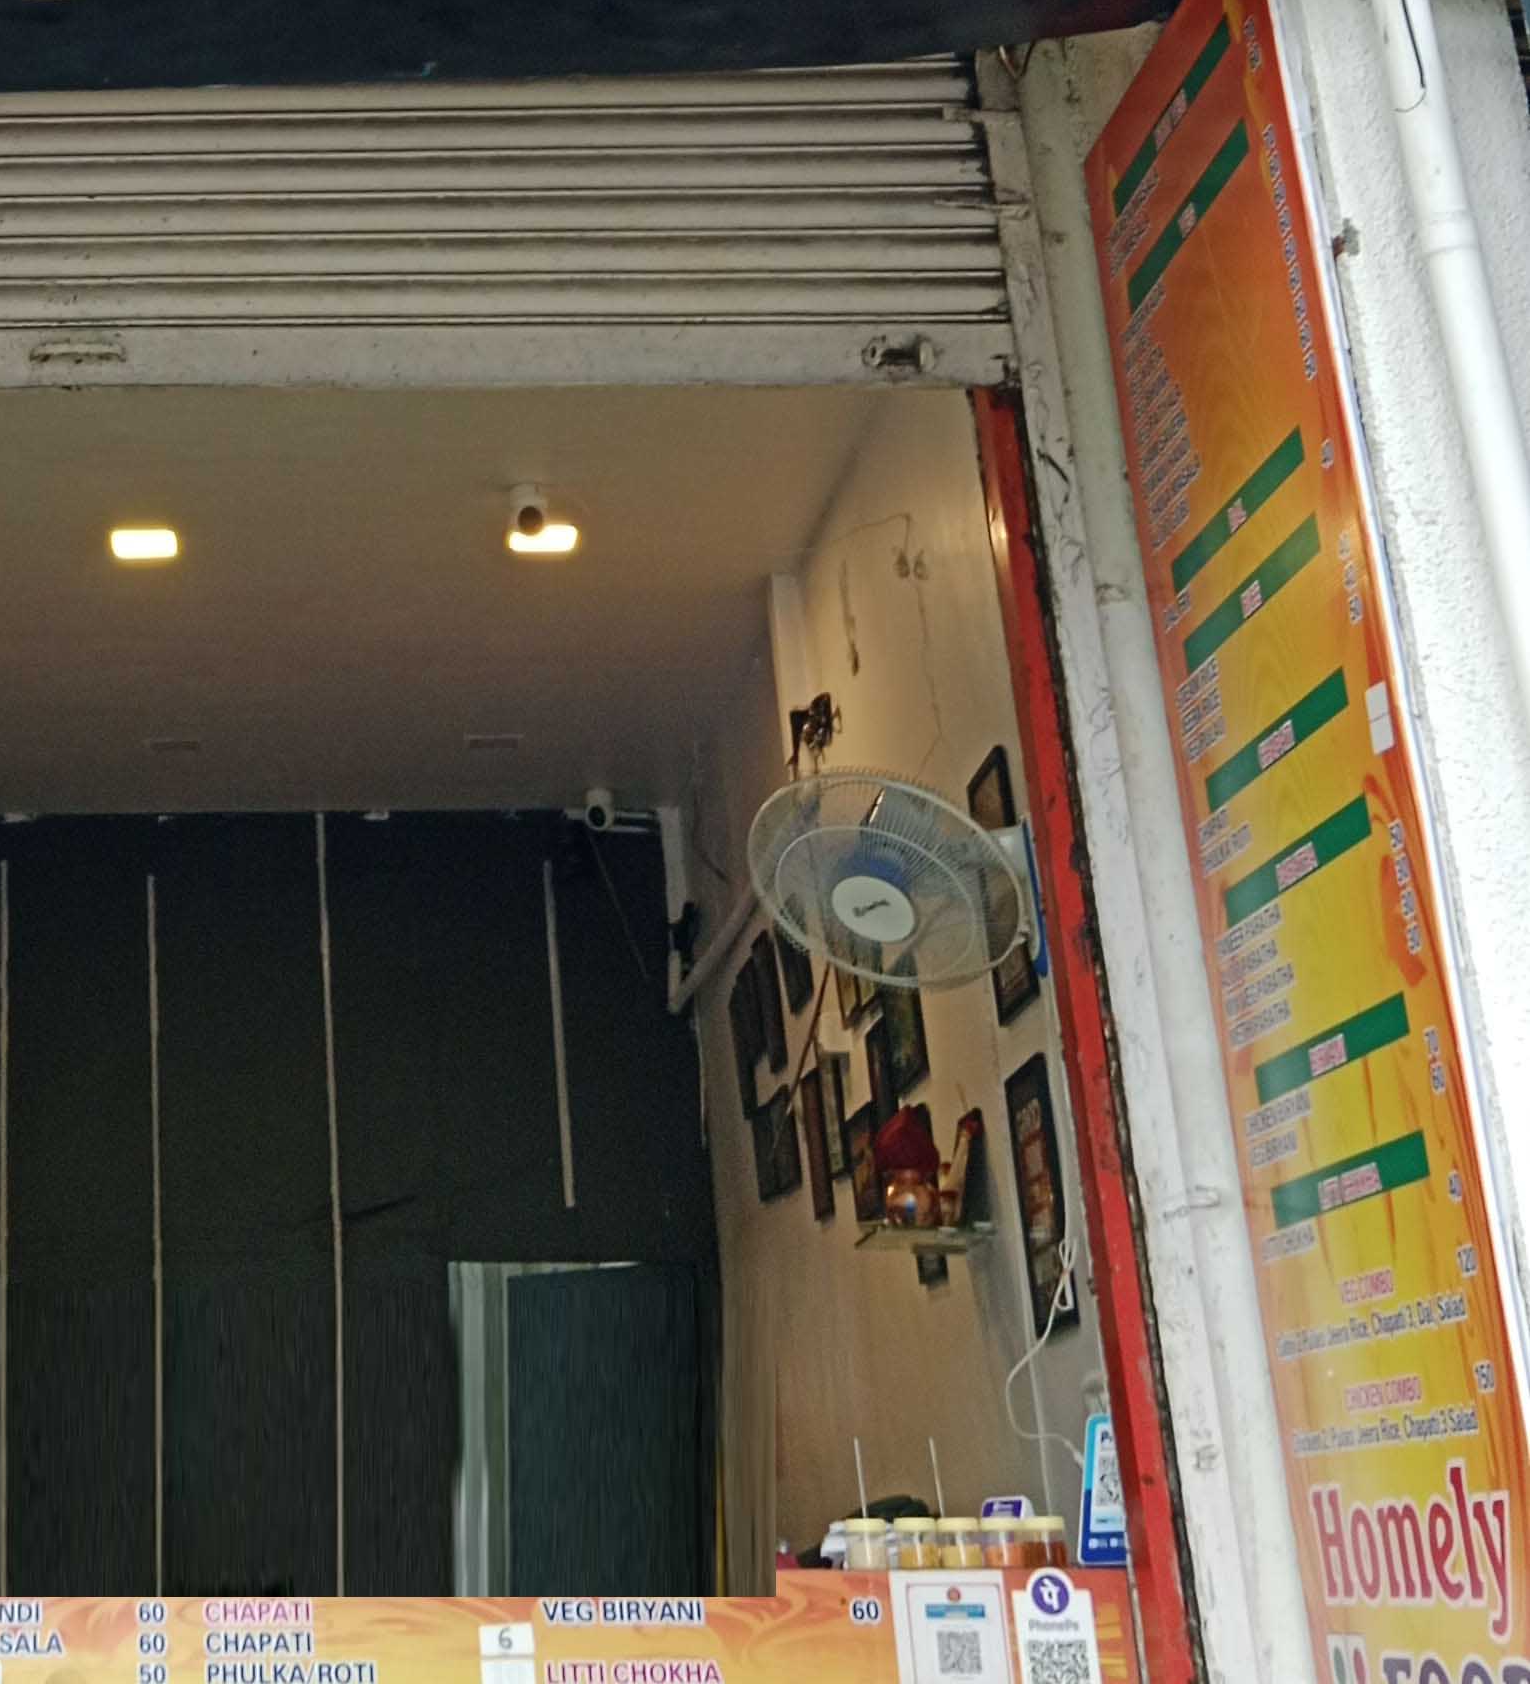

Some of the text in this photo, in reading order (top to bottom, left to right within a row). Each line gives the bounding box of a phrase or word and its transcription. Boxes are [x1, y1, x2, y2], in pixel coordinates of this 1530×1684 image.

[1311, 1465, 1509, 1637] Homely
[139, 1602, 165, 1623] 60
[204, 1602, 311, 1622] CHAPATI
[542, 1600, 879, 1621] VEG BIRYANI 60
[139, 1632, 166, 1654] 60
[206, 1633, 313, 1653] CHAPATI
[498, 1627, 513, 1650] 6
[139, 1664, 166, 1684] 50
[207, 1663, 376, 1683] PHULKA/ROTI
[546, 1663, 721, 1683] LITTI CHOKHA
